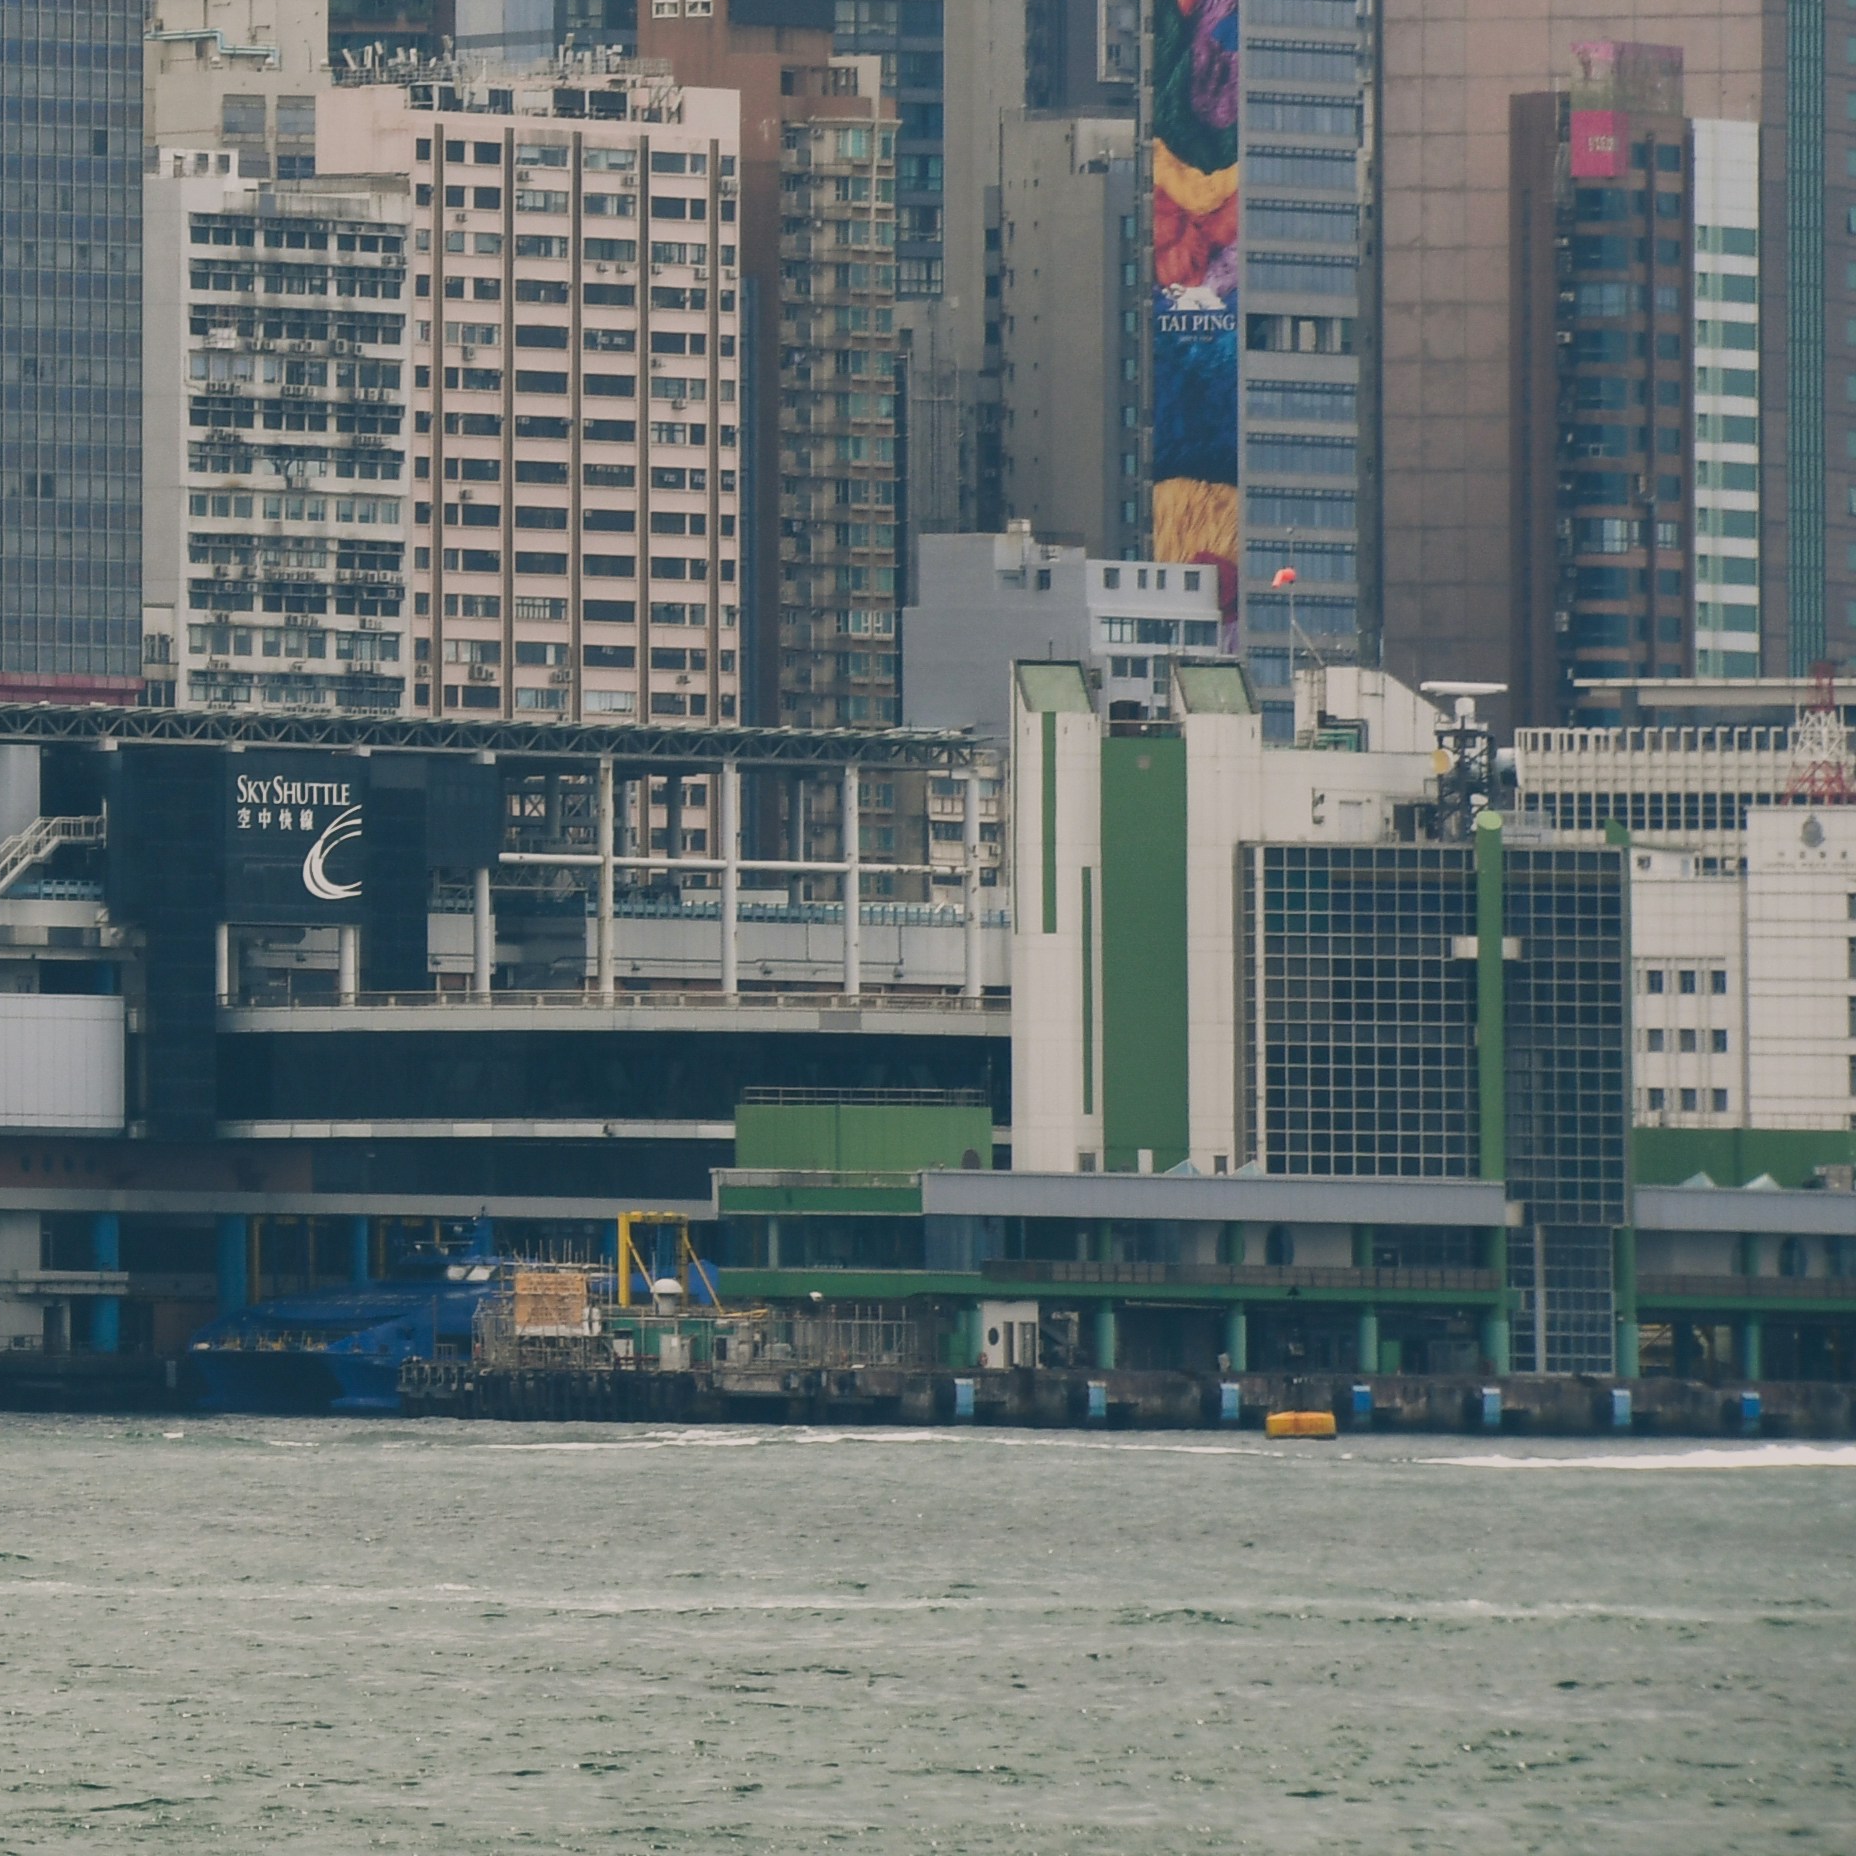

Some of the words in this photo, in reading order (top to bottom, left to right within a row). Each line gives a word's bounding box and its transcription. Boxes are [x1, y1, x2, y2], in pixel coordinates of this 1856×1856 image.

[1158, 314, 1187, 332] TAI
[1191, 313, 1237, 332] PING
[236, 806, 315, 831] 空中快線
